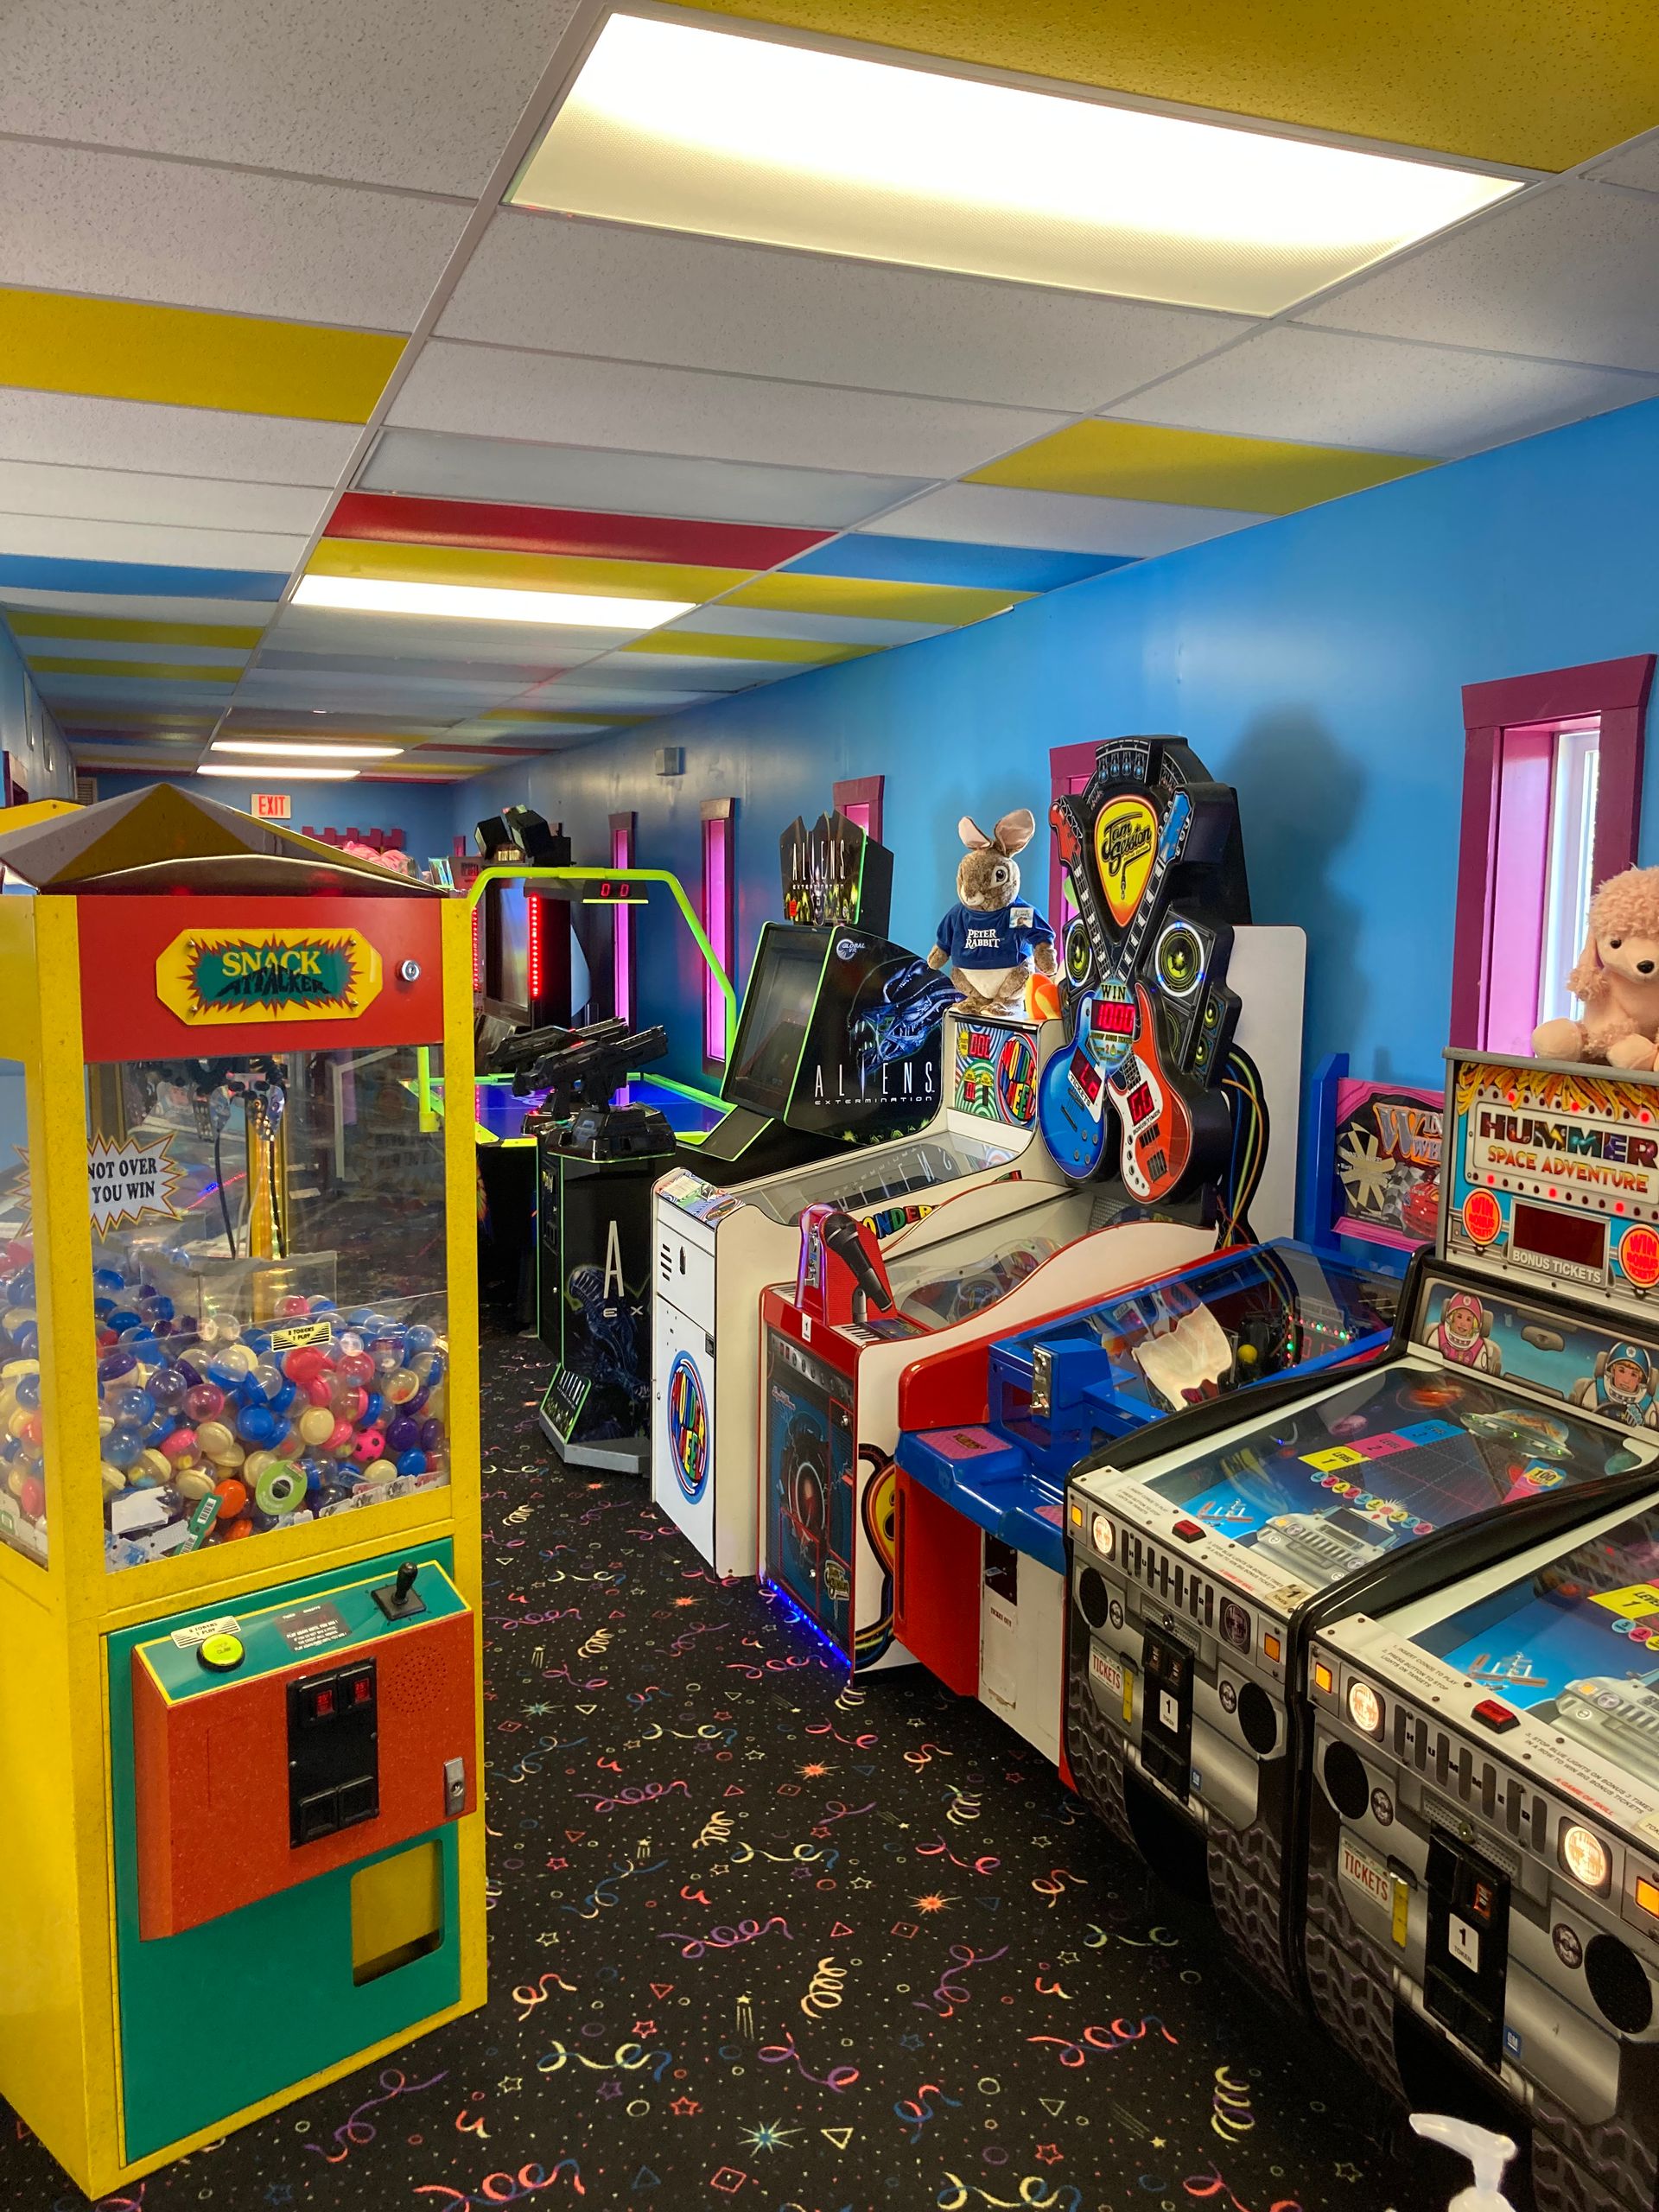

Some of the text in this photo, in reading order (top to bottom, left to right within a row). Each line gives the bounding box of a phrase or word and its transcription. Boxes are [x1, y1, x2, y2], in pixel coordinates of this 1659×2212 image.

[259, 796, 285, 816] EXIT
[1102, 812, 1142, 861] Jam
[792, 838, 845, 880] ALIENS
[1109, 825, 1152, 876] Session
[964, 938, 1000, 950] RABBIT
[968, 929, 996, 938] PETER
[222, 951, 322, 976] SNACK
[215, 963, 332, 997] ATTACKER
[1101, 984, 1126, 1000] WIN
[1098, 1004, 1135, 1033] 1000
[815, 1061, 933, 1099] ALIENS
[1070, 1077, 1091, 1107] TICKETS
[815, 1096, 932, 1105] EXTERMINATION
[1479, 1111, 1658, 1169] HUMMER
[88, 1158, 157, 1180] NOT OVER
[1488, 1145, 1649, 1193] SPACE ADVENTURE
[92, 1181, 156, 1204] YOU WIN
[1468, 1212, 1495, 1228] BONUS
[1470, 1197, 1494, 1217] WIN
[861, 1205, 934, 1239] ONDER
[1630, 1233, 1657, 1254] WIN
[1513, 1250, 1601, 1284] BONUS TICKETS
[1626, 1250, 1659, 1270] BONUS
[1332, 1452, 1354, 1463] LEVEL
[1380, 1439, 1402, 1449] LEVEL
[1535, 1471, 1556, 1482] 100
[1128, 1550, 1205, 1605] HUMMER
[1273, 1594, 1287, 1605] TOKEN
[1092, 1654, 1121, 1689] TICKETS
[1381, 1656, 1400, 1667] LIGHTS
[1408, 1671, 1432, 1688] TARGETS
[1389, 1652, 1405, 1663] PRESS
[1404, 1662, 1426, 1676] BUTTON
[1433, 1681, 1449, 1690] STOP
[1398, 1648, 1417, 1659] INSERT
[1442, 1675, 1459, 1685] PLAY
[1166, 1699, 1171, 1714] 1
[1406, 1732, 1531, 1823] HUMMER
[1532, 1736, 1550, 1748] STOP
[1549, 1746, 1567, 1758] BLUE
[1567, 1757, 1592, 1773] LIGHTS
[1599, 1778, 1626, 1795] BONUS
[1632, 1797, 1655, 1813] TIMES
[1538, 1748, 1556, 1758] ROW
[1564, 1763, 1577, 1773] WIN
[1577, 1771, 1590, 1781] BIG
[1589, 1779, 1615, 1796] BONUS
[1613, 1794, 1645, 1815] TICKETS
[1560, 1781, 1583, 1796] GAME
[1592, 1801, 1615, 1816] SKILL
[1645, 1822, 1659, 1835] TOK
[1344, 1851, 1389, 1901] TICKETS
[1459, 1928, 1466, 1946] 1
[1453, 1945, 1472, 1964] TOKEN
[1507, 2031, 1519, 2050] GM
